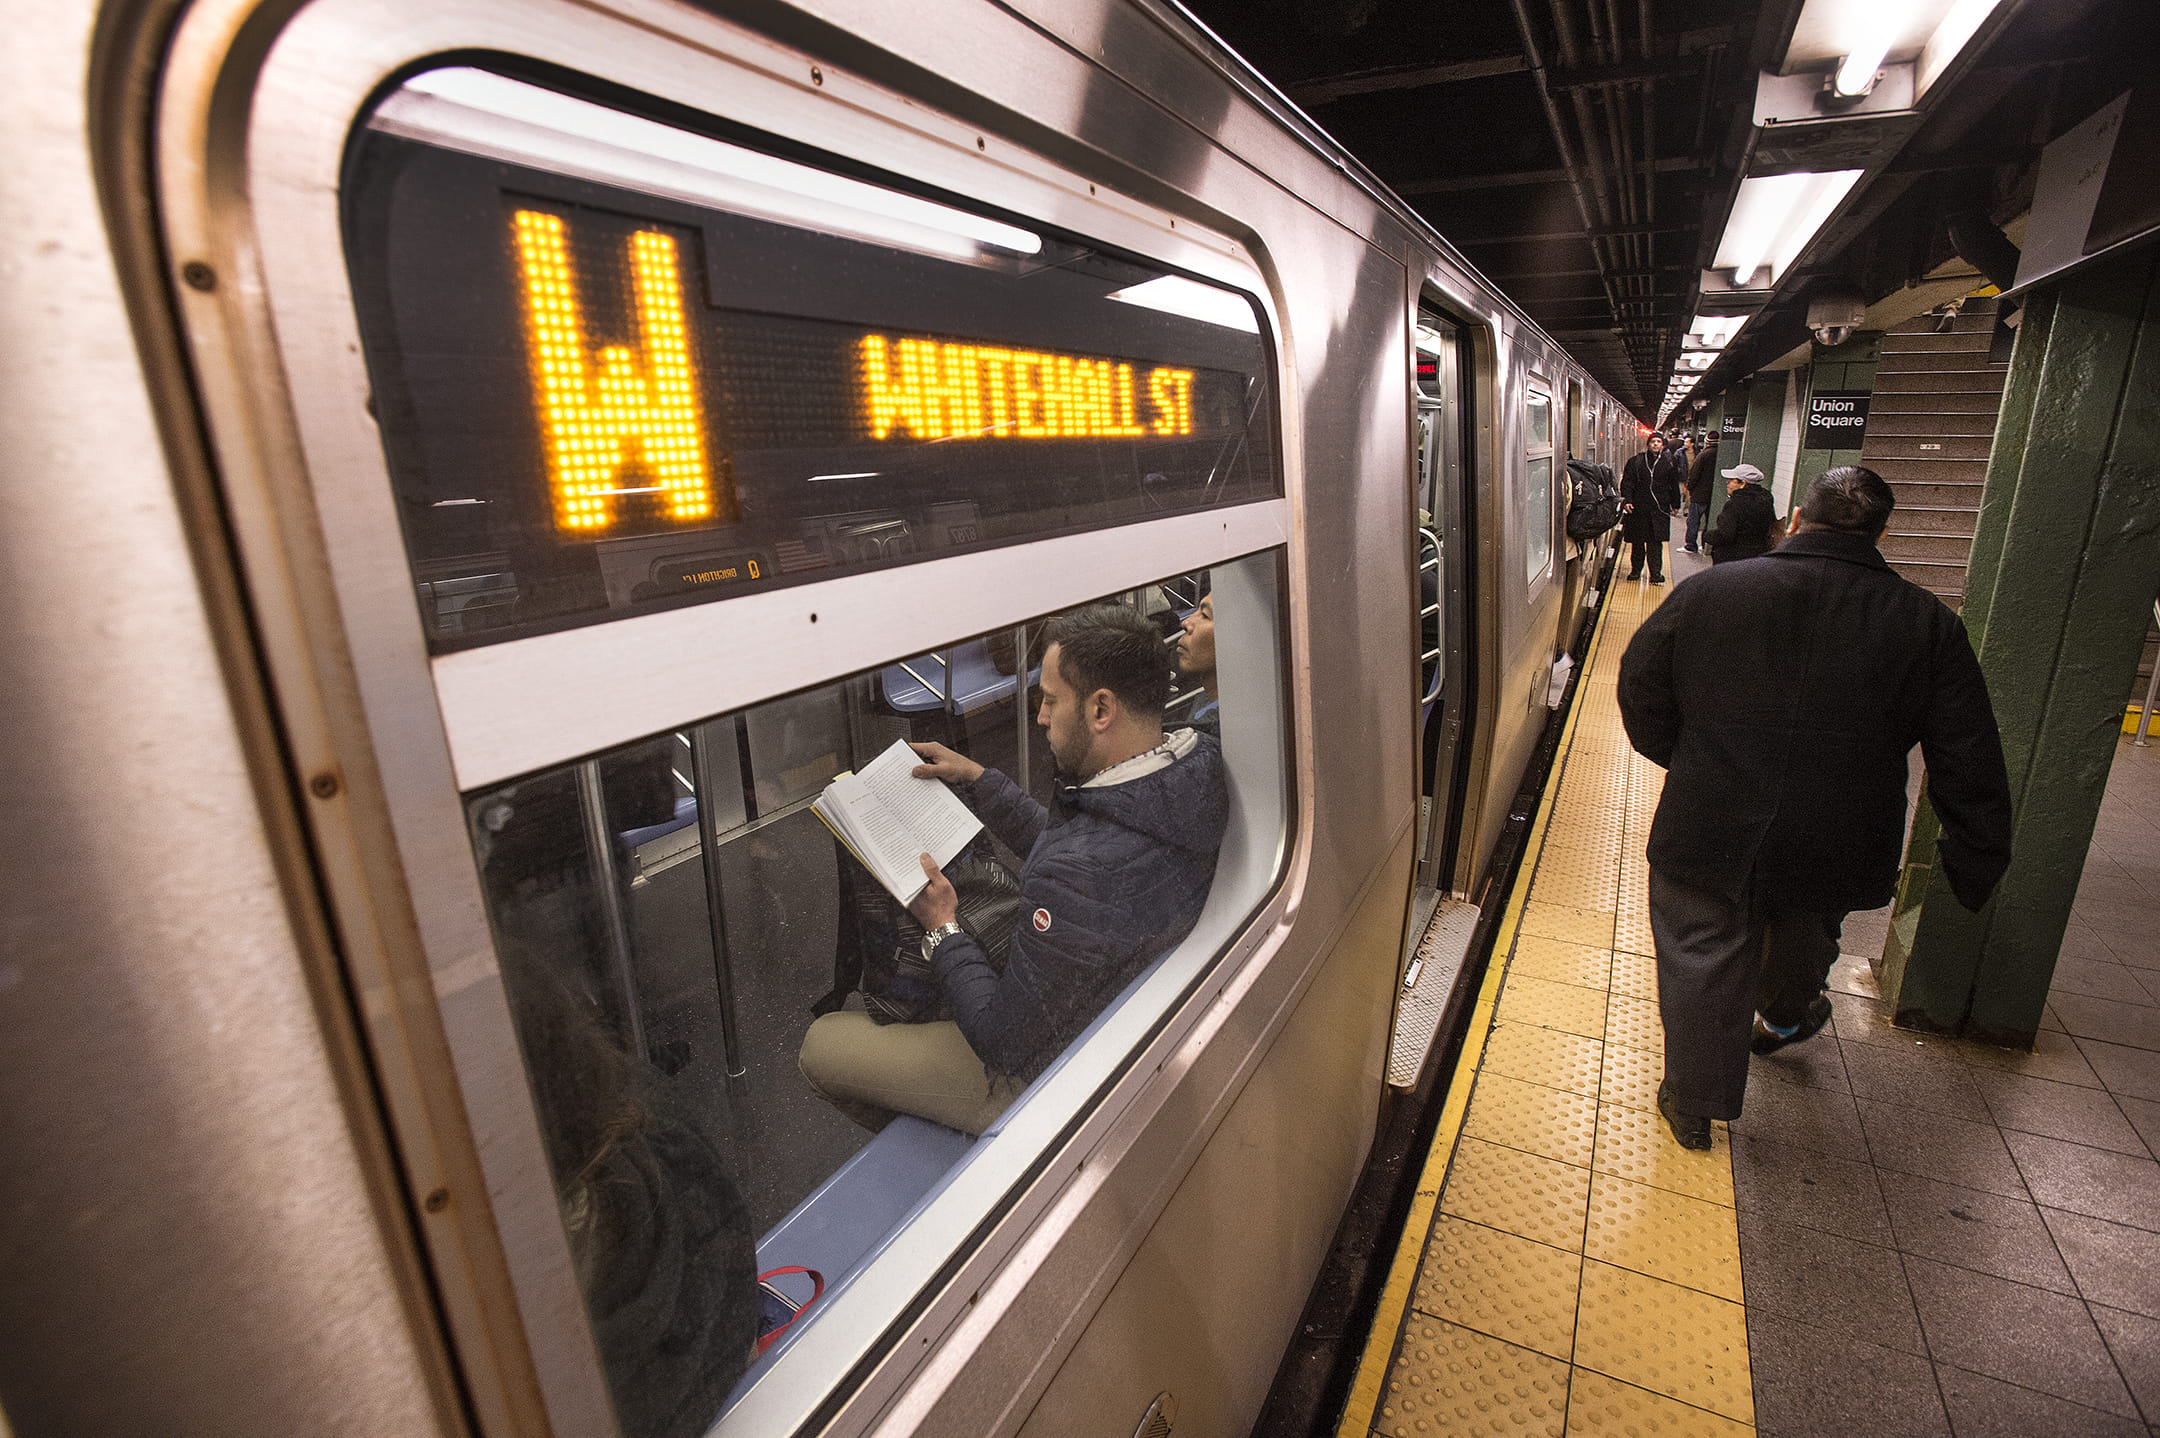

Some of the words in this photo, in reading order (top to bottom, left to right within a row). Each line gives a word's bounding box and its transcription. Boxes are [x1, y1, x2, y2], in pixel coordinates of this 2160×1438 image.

[514, 210, 711, 528] W
[863, 335, 1143, 439] WHITEHALL
[1151, 367, 1193, 435] ST
[1812, 400, 1855, 412] Union
[1722, 425, 1746, 433] Stree
[1810, 414, 1864, 429] Square
